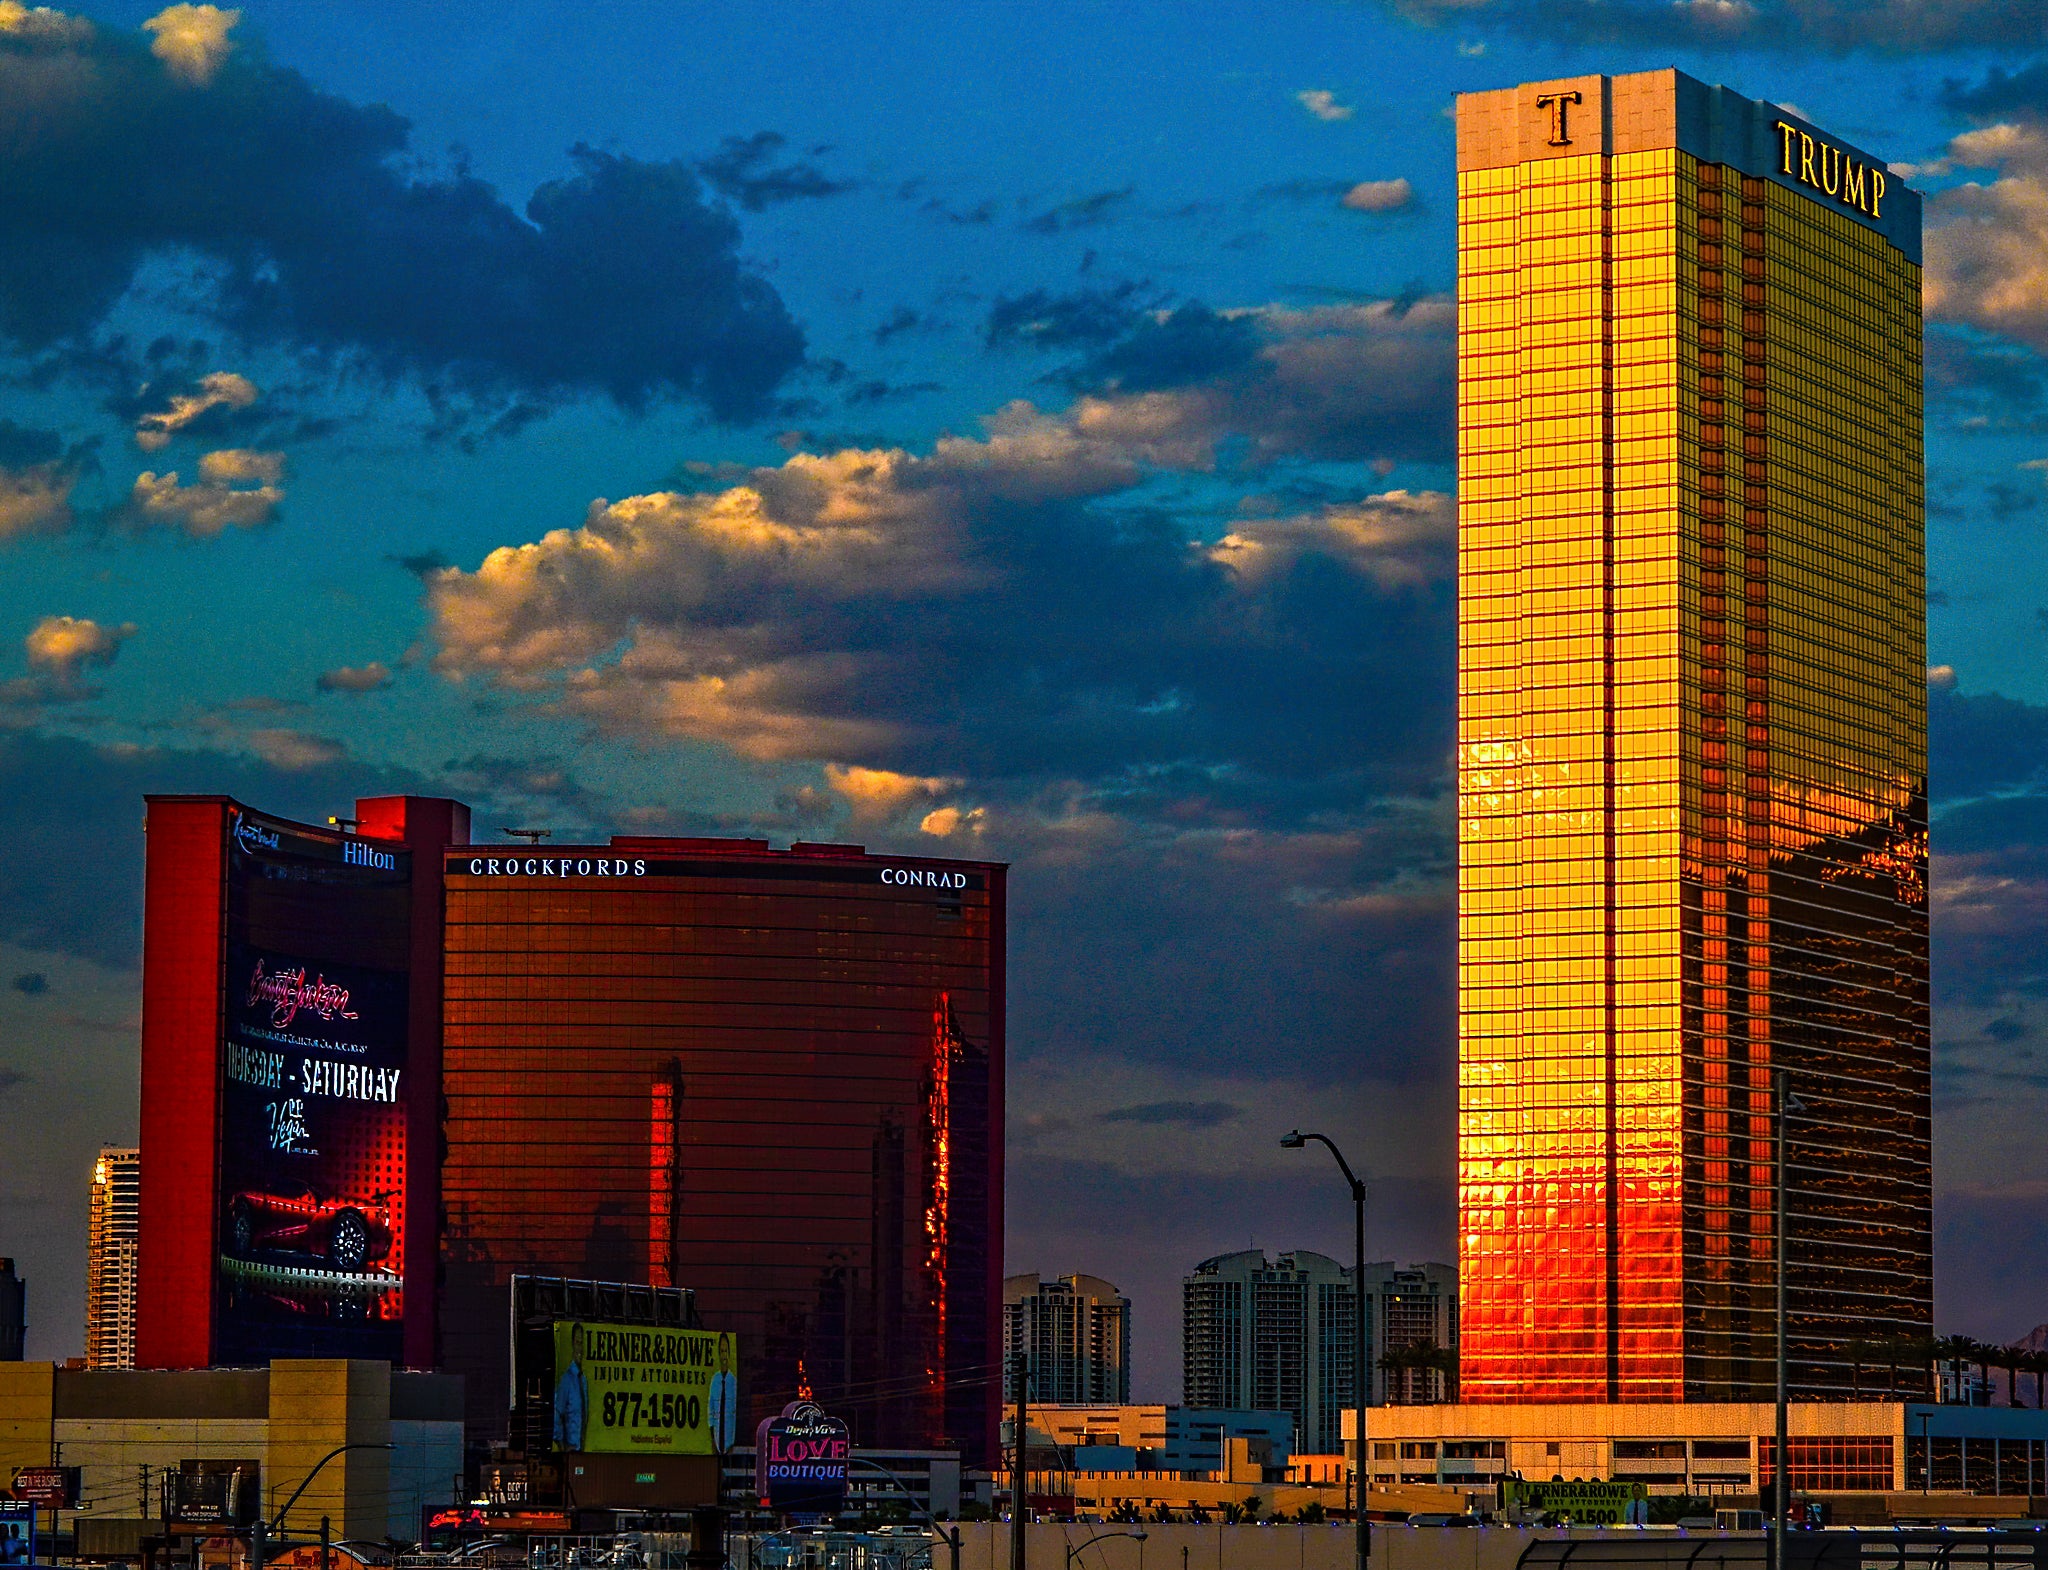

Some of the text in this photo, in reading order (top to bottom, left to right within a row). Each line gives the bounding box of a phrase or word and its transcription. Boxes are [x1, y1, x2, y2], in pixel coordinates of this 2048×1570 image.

[1536, 91, 1582, 147] T
[1776, 120, 1886, 218] TRUMP
[343, 841, 395, 870] Hilton
[470, 858, 645, 878] CROCKFORDS
[880, 868, 967, 888] CONRAD
[302, 1058, 401, 1103] SATURDAY
[586, 1330, 715, 1367] LERNER&ROWE
[594, 1366, 706, 1386] INJURY ATTORNEYS
[603, 1391, 700, 1429] 877-1500
[769, 1435, 847, 1462] LOVE
[769, 1465, 846, 1480] BOUTIQUE
